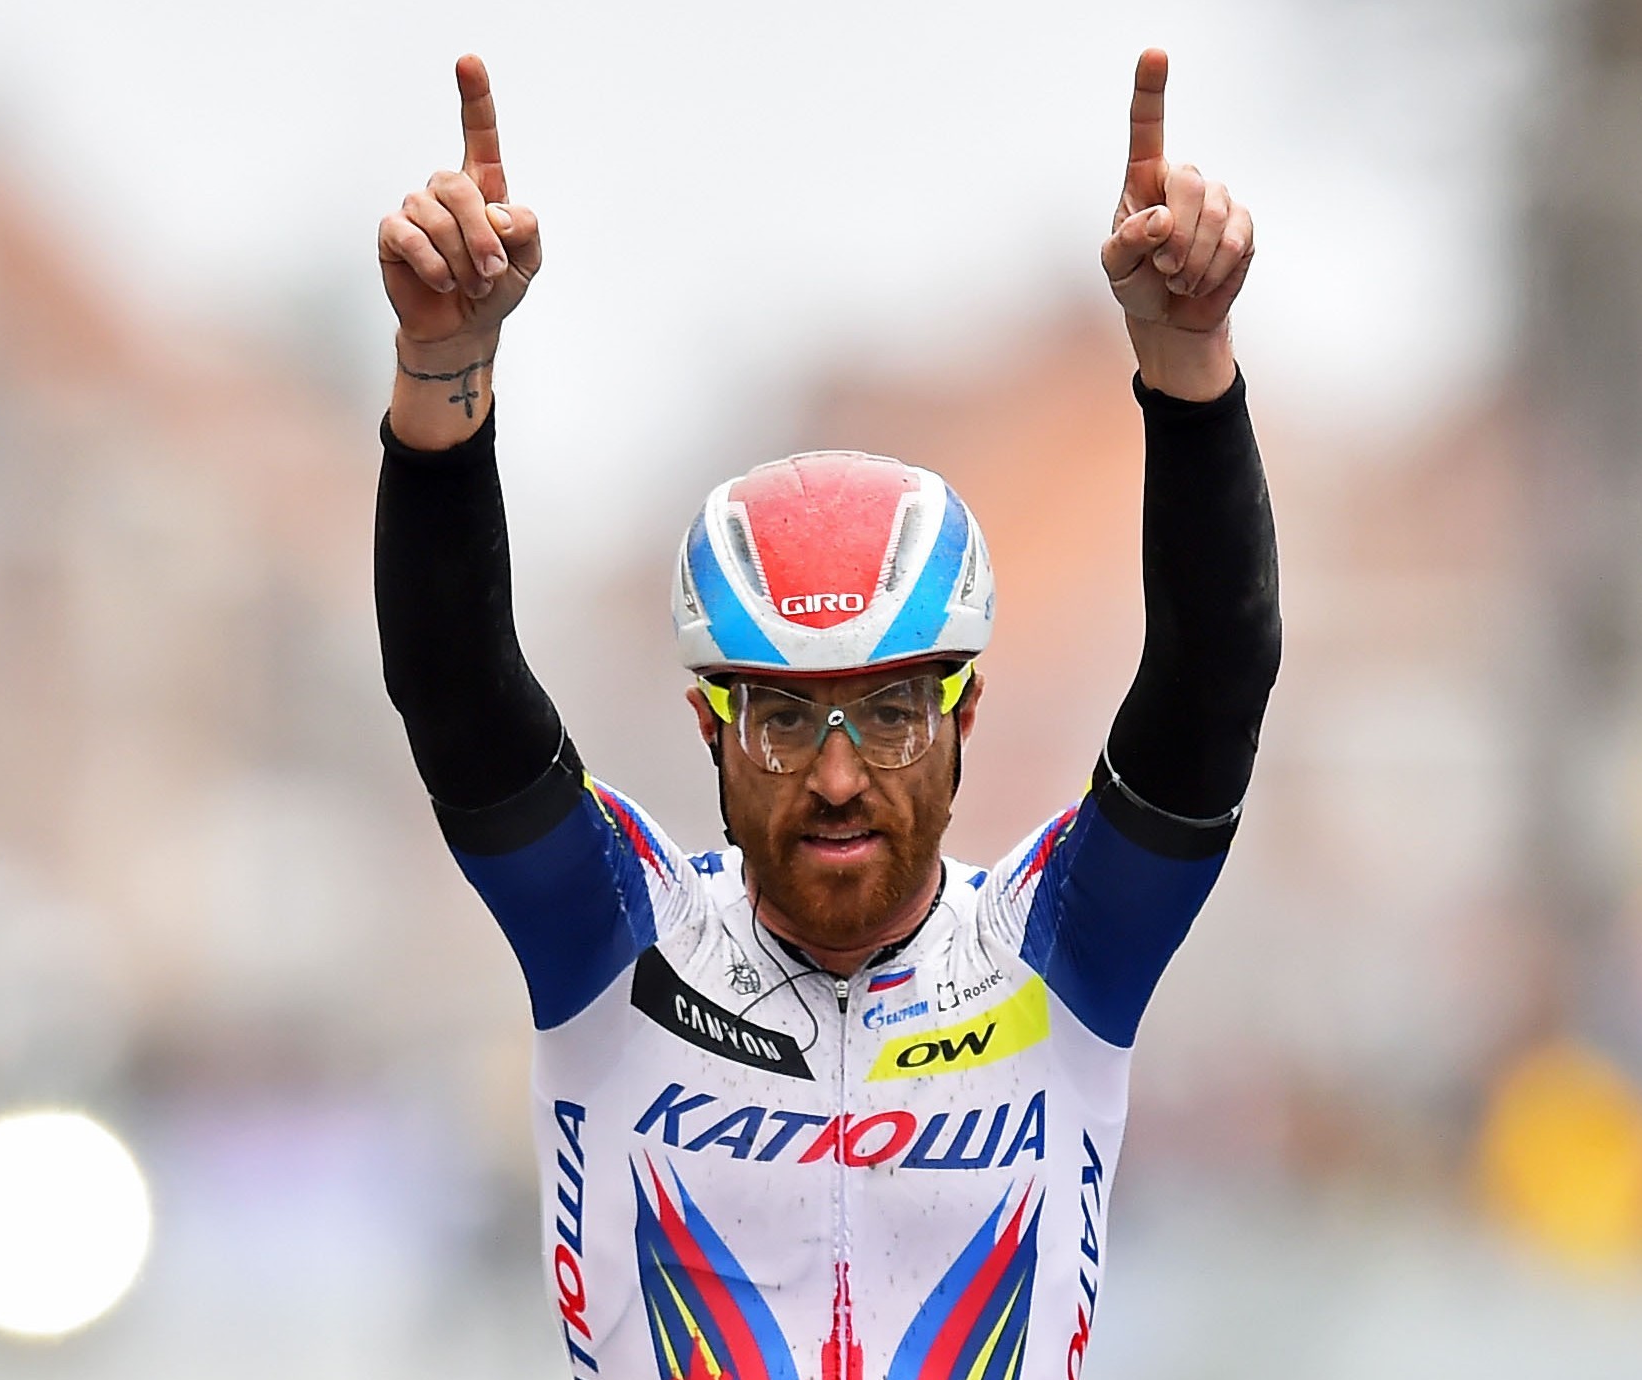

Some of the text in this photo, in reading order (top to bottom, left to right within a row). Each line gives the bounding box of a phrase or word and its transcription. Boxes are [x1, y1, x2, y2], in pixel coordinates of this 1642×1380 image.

[781, 593, 865, 615] GIRO
[963, 969, 1004, 1002] Rostec
[675, 994, 782, 1061] CANYON
[896, 1022, 997, 1068] OW
[633, 1082, 1046, 1169] КАТЮША
